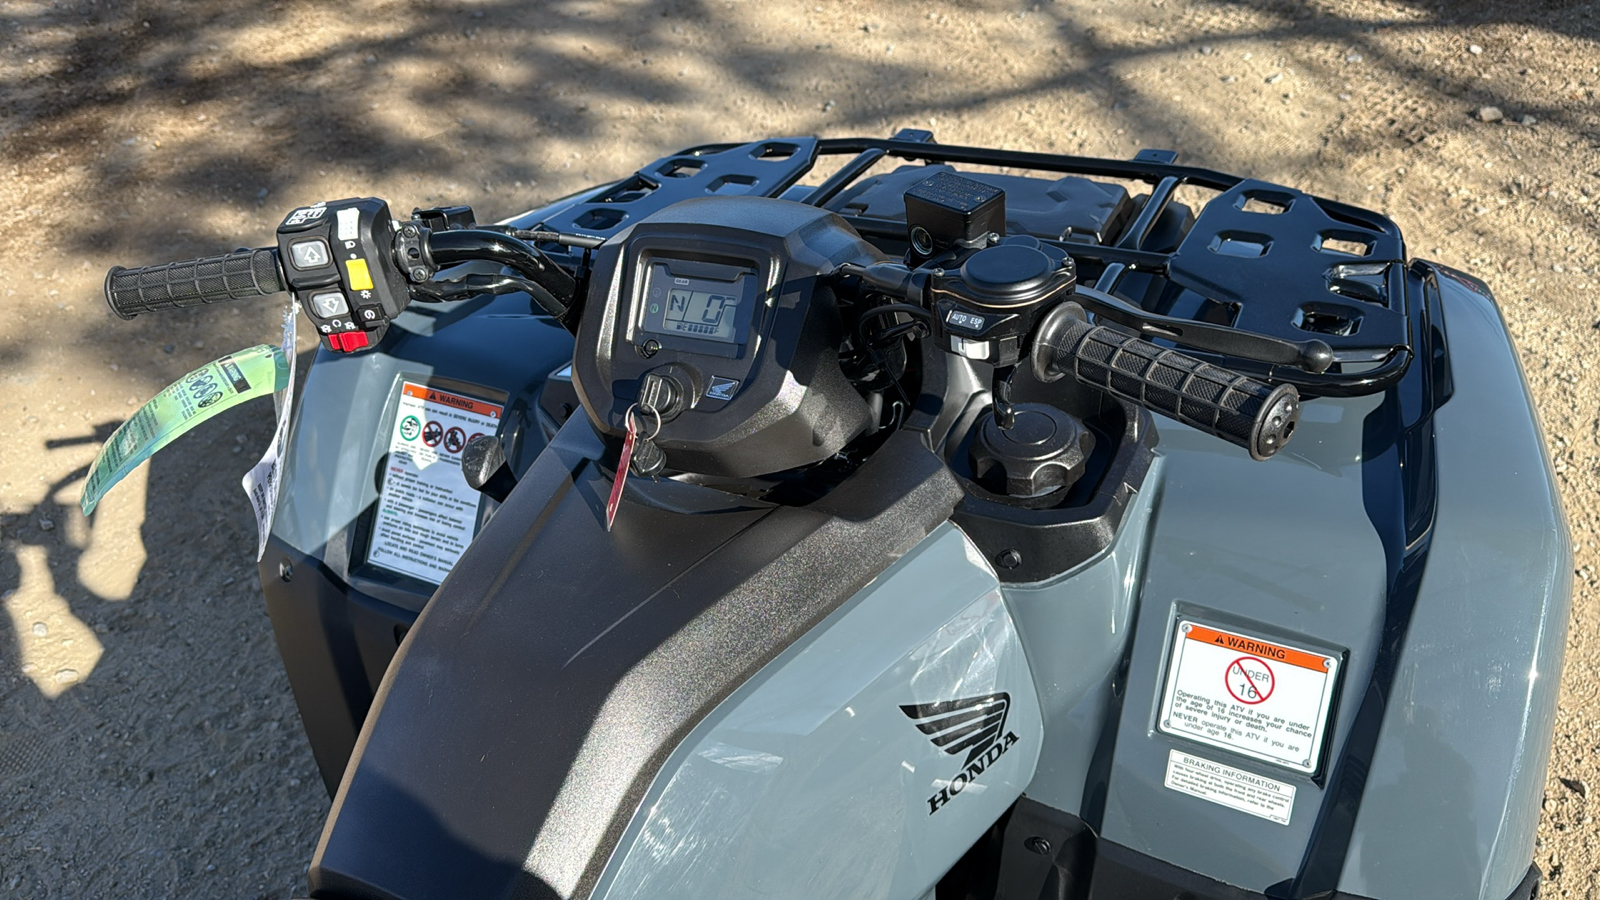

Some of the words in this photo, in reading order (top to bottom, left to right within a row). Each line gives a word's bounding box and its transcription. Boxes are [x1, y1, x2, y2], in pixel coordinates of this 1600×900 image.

[670, 294, 685, 312] N
[702, 294, 726, 323] 0
[952, 313, 967, 322] AUTO
[970, 317, 983, 326] ESP
[439, 395, 474, 409] WARNING
[1227, 636, 1286, 660] WARNING
[1232, 665, 1270, 683] UNDER
[1238, 682, 1258, 700] 16
[1176, 696, 1187, 704] the
[1190, 699, 1203, 709] age
[1229, 709, 1262, 725] increases
[1266, 720, 1282, 731] your
[1286, 726, 1312, 739] chance
[1177, 689, 1211, 705] Operating
[1214, 700, 1227, 709] this
[1230, 704, 1245, 713] ATV
[1256, 712, 1270, 721] you
[1273, 716, 1285, 724] are
[1288, 720, 1310, 732] under
[1185, 705, 1208, 716] severe
[1211, 712, 1231, 723] injury
[1246, 721, 1267, 733] death.
[1173, 711, 1198, 724] NEVER
[1201, 719, 1227, 733] operate
[1230, 727, 1243, 736] this
[1245, 731, 1260, 741] ATV
[1271, 739, 1284, 750] you
[1288, 744, 1300, 753] are
[1184, 721, 1203, 732] under
[1206, 728, 1220, 738] age
[1224, 732, 1234, 740] 16.
[927, 730, 1020, 816] HONDA
[1183, 756, 1221, 774] BRAKING
[1222, 768, 1280, 792] INFORMATION
